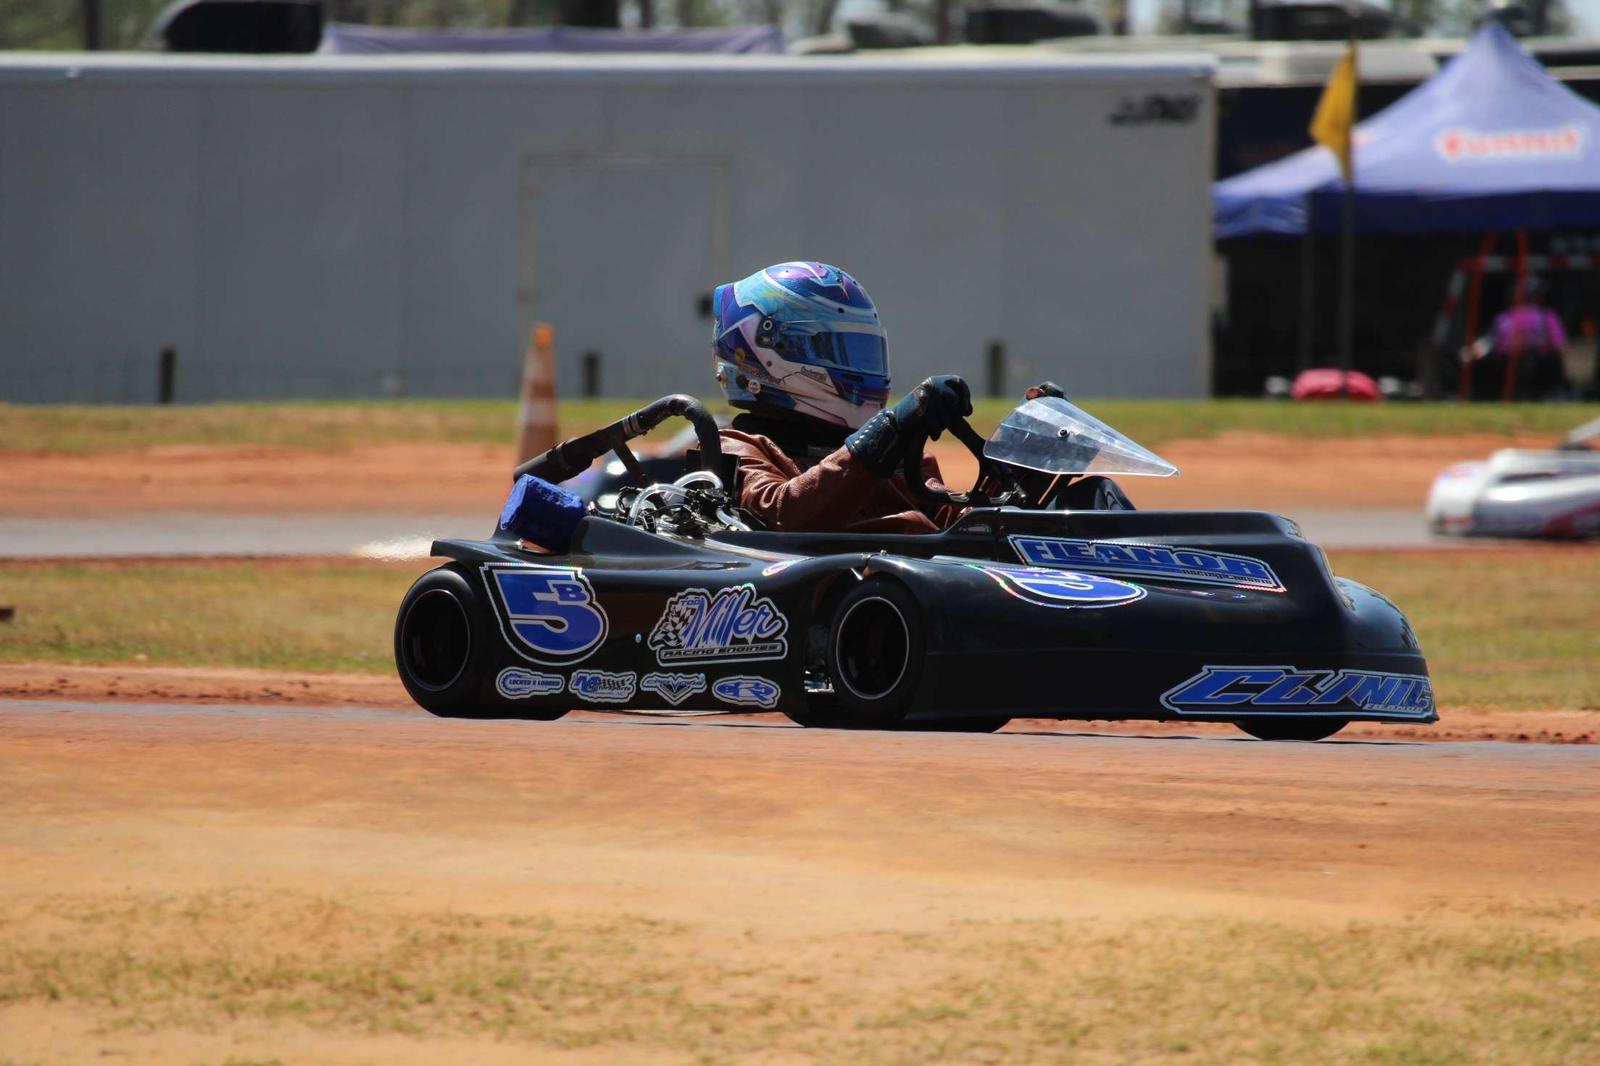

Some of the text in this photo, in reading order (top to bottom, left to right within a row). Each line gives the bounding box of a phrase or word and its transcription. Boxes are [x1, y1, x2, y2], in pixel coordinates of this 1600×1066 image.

[682, 589, 782, 649] Miller
[663, 644, 780, 657] RACING ENGINES
[1169, 670, 1433, 708] CLINIC
